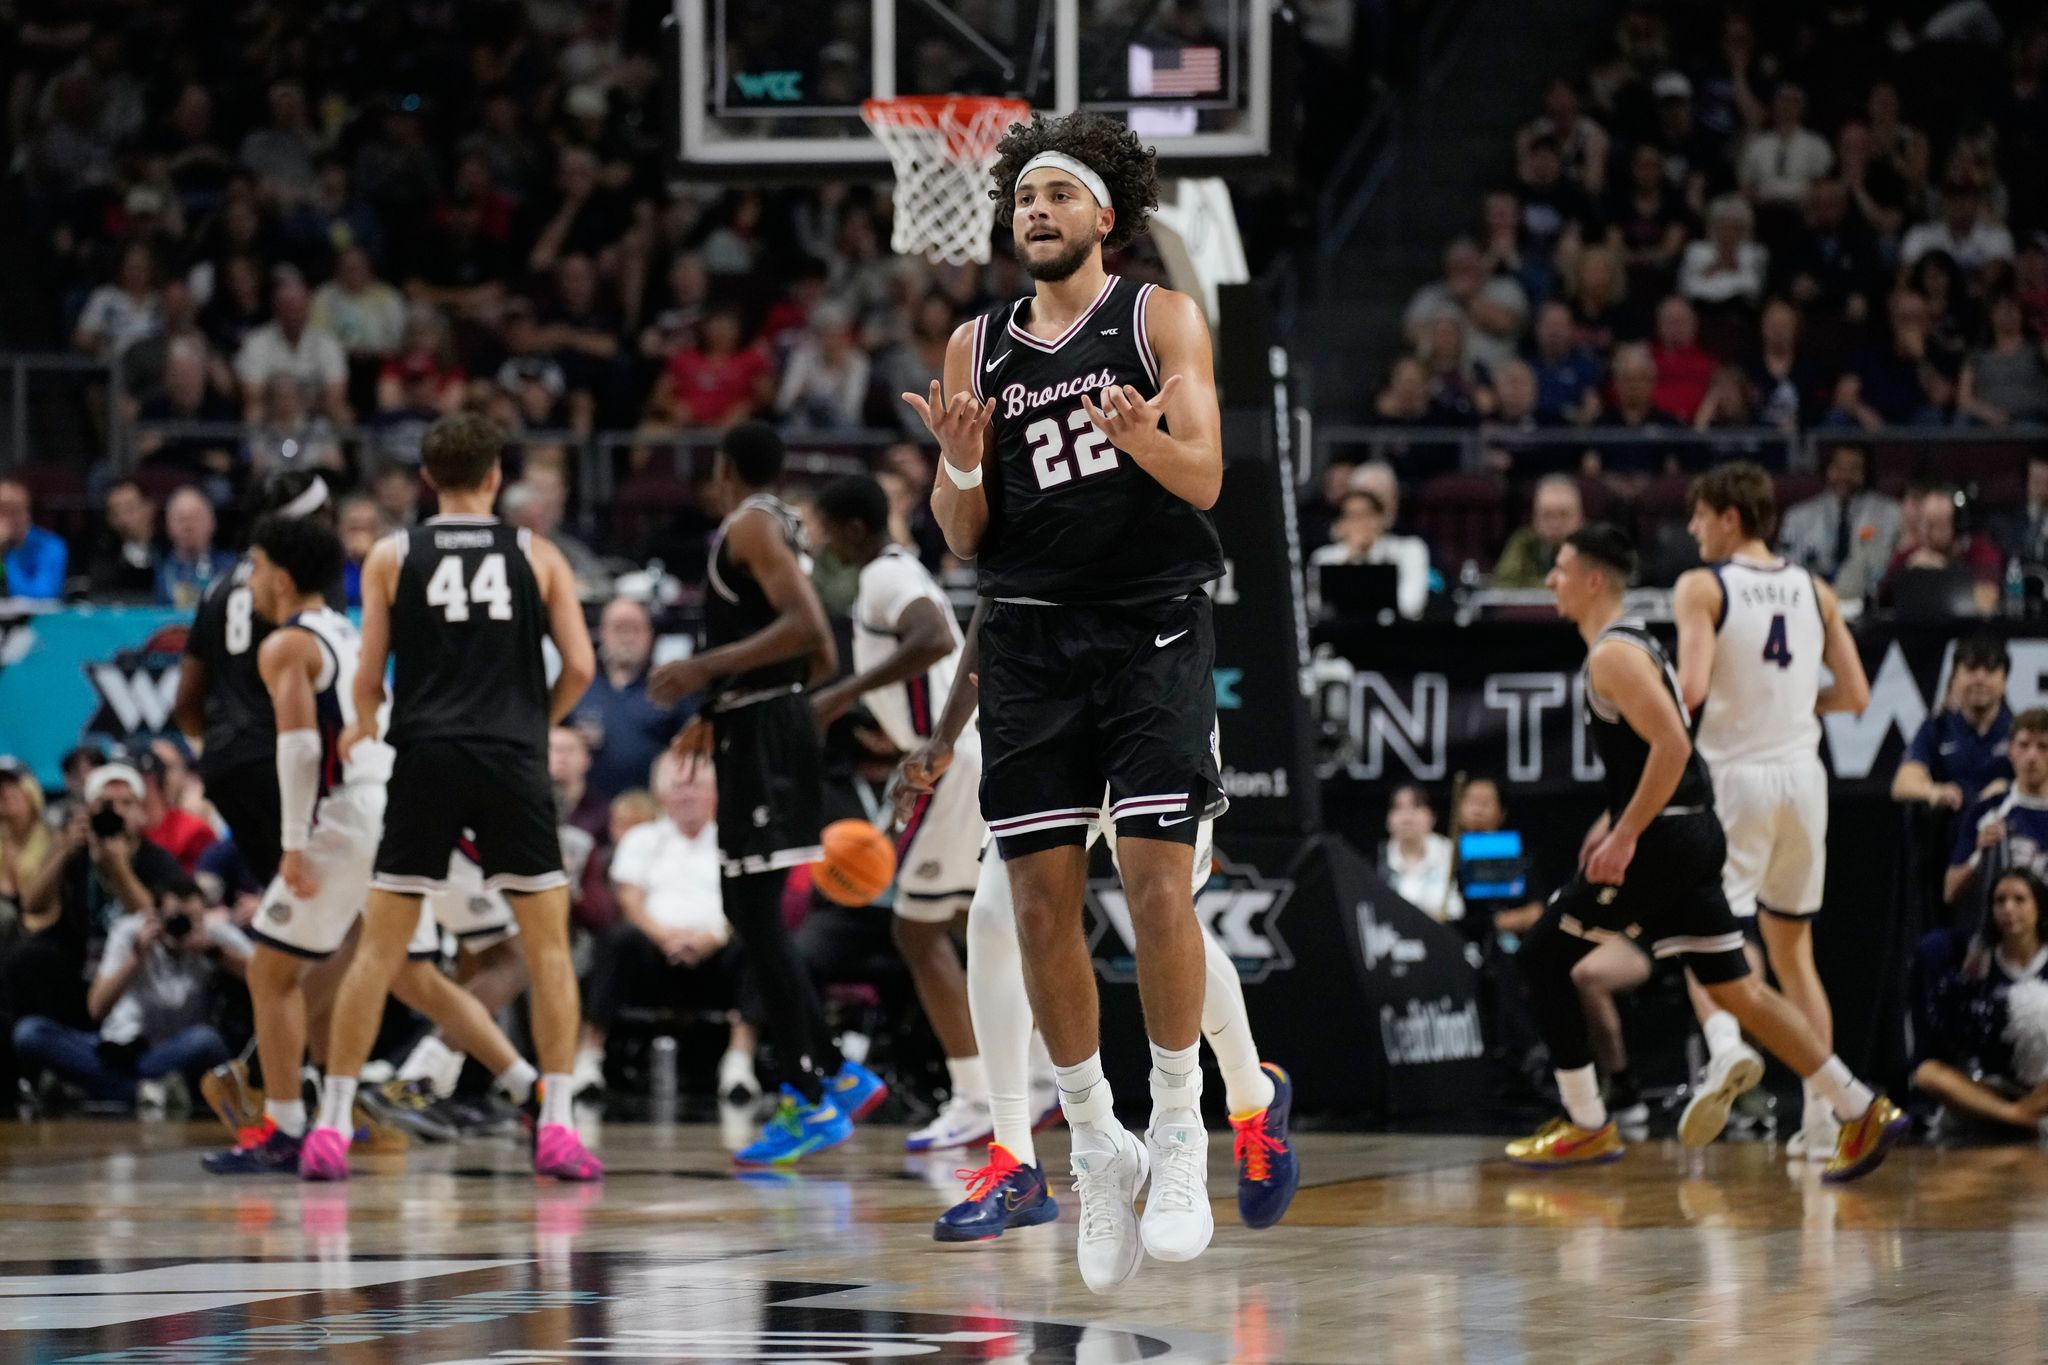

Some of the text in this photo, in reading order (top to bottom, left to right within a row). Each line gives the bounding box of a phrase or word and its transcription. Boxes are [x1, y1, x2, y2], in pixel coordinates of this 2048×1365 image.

[1002, 368, 1116, 420] Broncos
[1025, 406, 1119, 490] 22
[426, 553, 513, 622] 44
[225, 588, 253, 655] 8
[1761, 613, 1793, 669] 4
